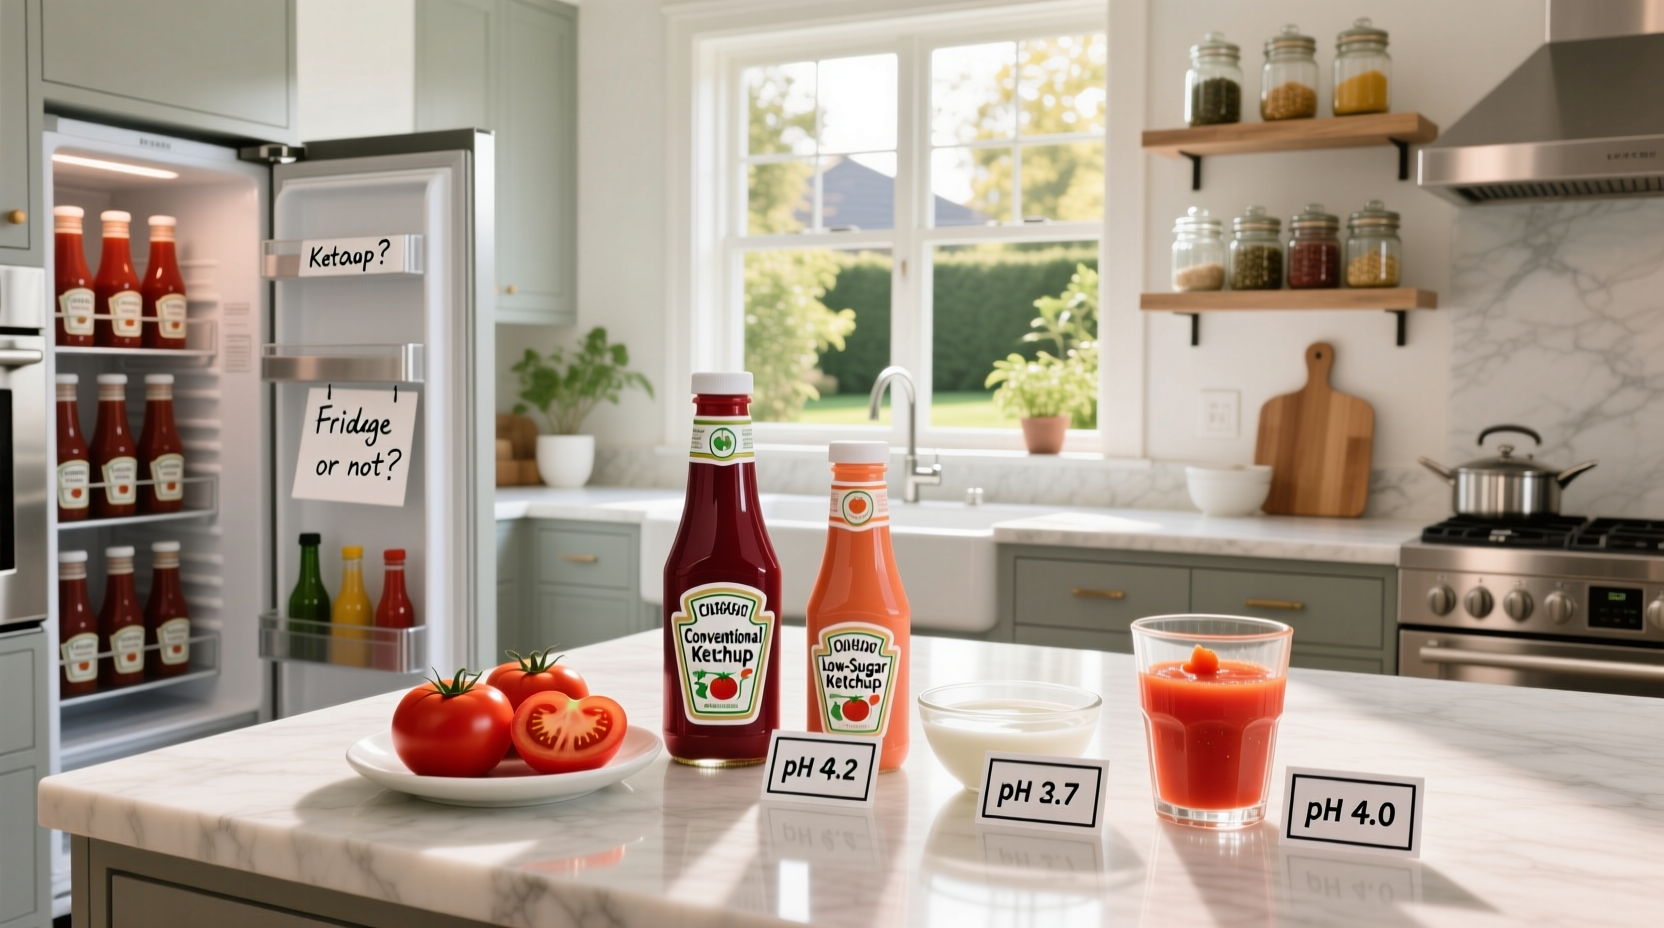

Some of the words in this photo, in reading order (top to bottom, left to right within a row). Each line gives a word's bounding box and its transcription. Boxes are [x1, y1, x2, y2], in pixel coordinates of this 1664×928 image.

[316, 459, 340, 476] or
[347, 448, 403, 481] not?
[684, 626, 763, 644] Conventional
[691, 645, 754, 668] Ketchup
[822, 656, 888, 678] Low-Sugar
[826, 673, 882, 694] Ketchup
[781, 756, 815, 784] pH
[819, 756, 858, 781] 4.2
[996, 780, 1033, 808] pH
[1039, 781, 1080, 806] 3.7
[1304, 798, 1343, 828] pH
[1351, 800, 1396, 827] 4.0
